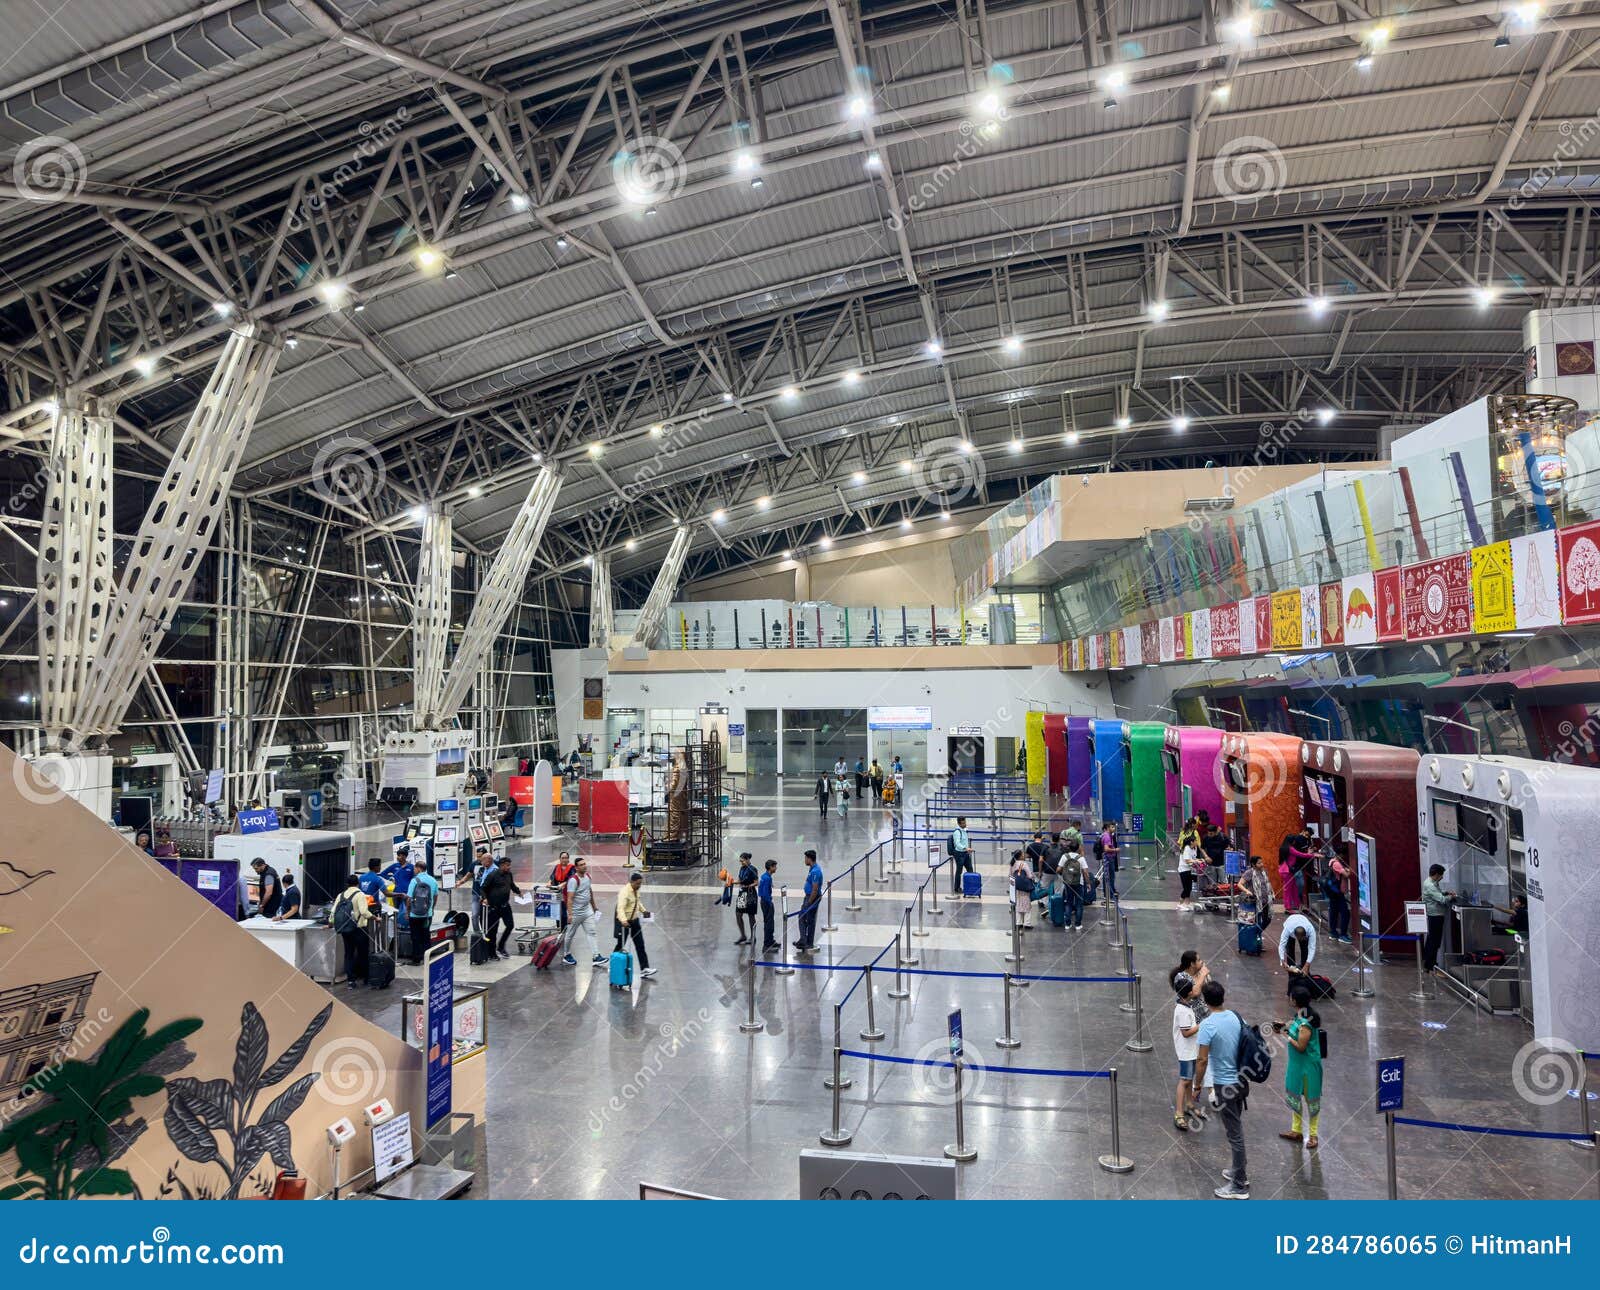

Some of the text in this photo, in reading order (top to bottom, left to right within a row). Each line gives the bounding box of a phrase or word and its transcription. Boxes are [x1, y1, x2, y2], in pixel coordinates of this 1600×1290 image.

[1419, 811, 1427, 826] 17
[1527, 846, 1540, 868] 18
[1381, 1069, 1401, 1083] Exit
